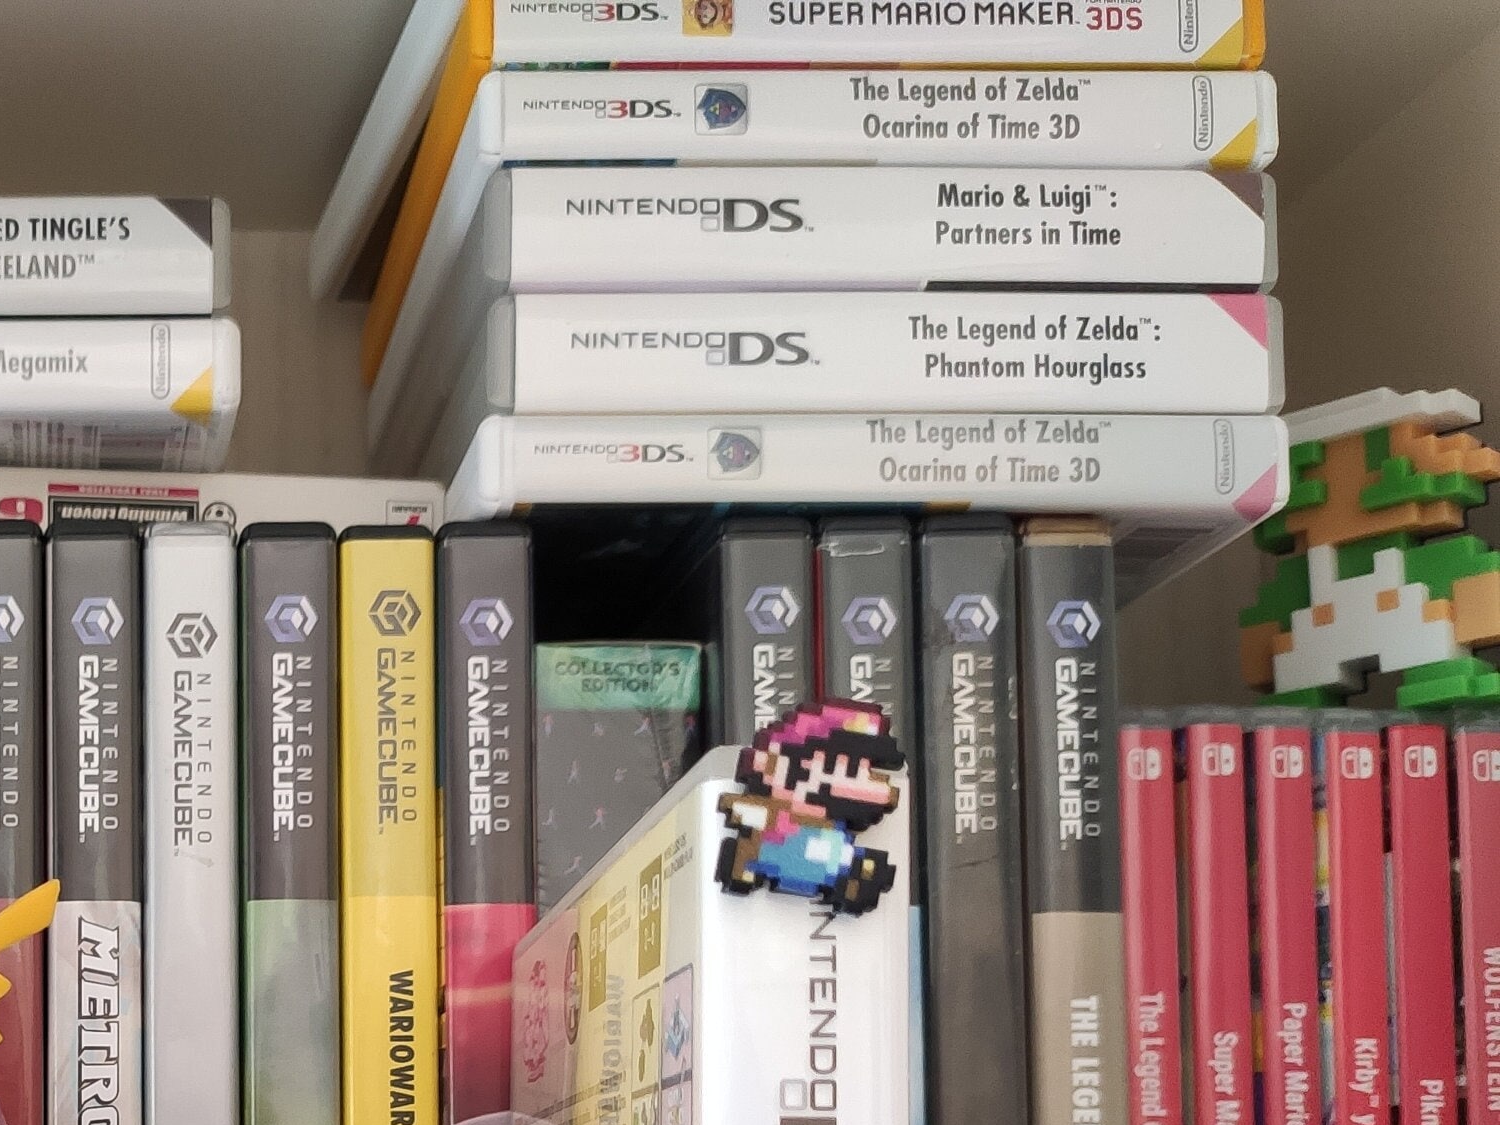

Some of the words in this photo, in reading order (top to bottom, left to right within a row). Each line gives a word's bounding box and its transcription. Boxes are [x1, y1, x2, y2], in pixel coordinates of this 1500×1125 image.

[769, 2, 867, 26] SUPER
[874, 2, 966, 26] MARIO
[973, 2, 1076, 26] MAKER
[1085, 7, 1143, 31] 3DS
[606, 98, 674, 120] 3DS
[850, 78, 890, 102] The
[897, 78, 976, 107] Legend
[984, 78, 1008, 103] of
[1195, 80, 1210, 147] Nintendo
[863, 115, 950, 140] Ocarina
[956, 115, 983, 140] of
[989, 115, 1040, 140] Time
[1049, 116, 1081, 140] 3D
[566, 198, 719, 216] NINTENDO
[722, 198, 804, 233] DS
[938, 185, 1005, 209] Mario
[1013, 185, 1029, 209] &
[29, 218, 131, 242] TINGLE'S
[935, 222, 1031, 246] Partners
[1041, 222, 1061, 246] in
[1069, 222, 1121, 246] Time
[570, 332, 724, 350] NINTENDO
[727, 332, 811, 367] DS
[908, 317, 949, 342] The
[957, 317, 1037, 345] Legend
[1044, 317, 1068, 342] of
[925, 355, 1025, 380] Phantom
[1033, 355, 1146, 384] Hourglass
[866, 420, 908, 445] The
[915, 420, 996, 450] Legend
[1002, 420, 1031, 445] of
[879, 458, 968, 483] Ocarina
[974, 458, 1000, 483] of
[1005, 458, 1058, 484] Time
[1067, 459, 1100, 483] 3D
[4, 657, 18, 828] NINTENDO
[79, 655, 99, 834] GAMECUBE
[103, 659, 118, 831] NINTENDO
[174, 671, 193, 847] GAMECUBE
[197, 673, 212, 844] NINTENDO
[273, 652, 294, 832] GAMECUBE
[297, 657, 312, 828] NINTENDO
[377, 648, 398, 825] GAMECUBE
[401, 651, 416, 823] NINTENDO
[468, 656, 491, 836] GAMECUBE
[493, 659, 509, 832] NINTENDO
[953, 653, 978, 835] GAMECUBE
[978, 655, 998, 831] NINTENDO
[1056, 658, 1083, 841] GAMECUBE
[1079, 662, 1100, 837] NINTENDO
[1070, 996, 1100, 1049] THE
[1140, 993, 1165, 1032] The
[1277, 1002, 1307, 1065] Paper
[1134, 1038, 1167, 1117] Legend
[1208, 1032, 1238, 1095] Super
